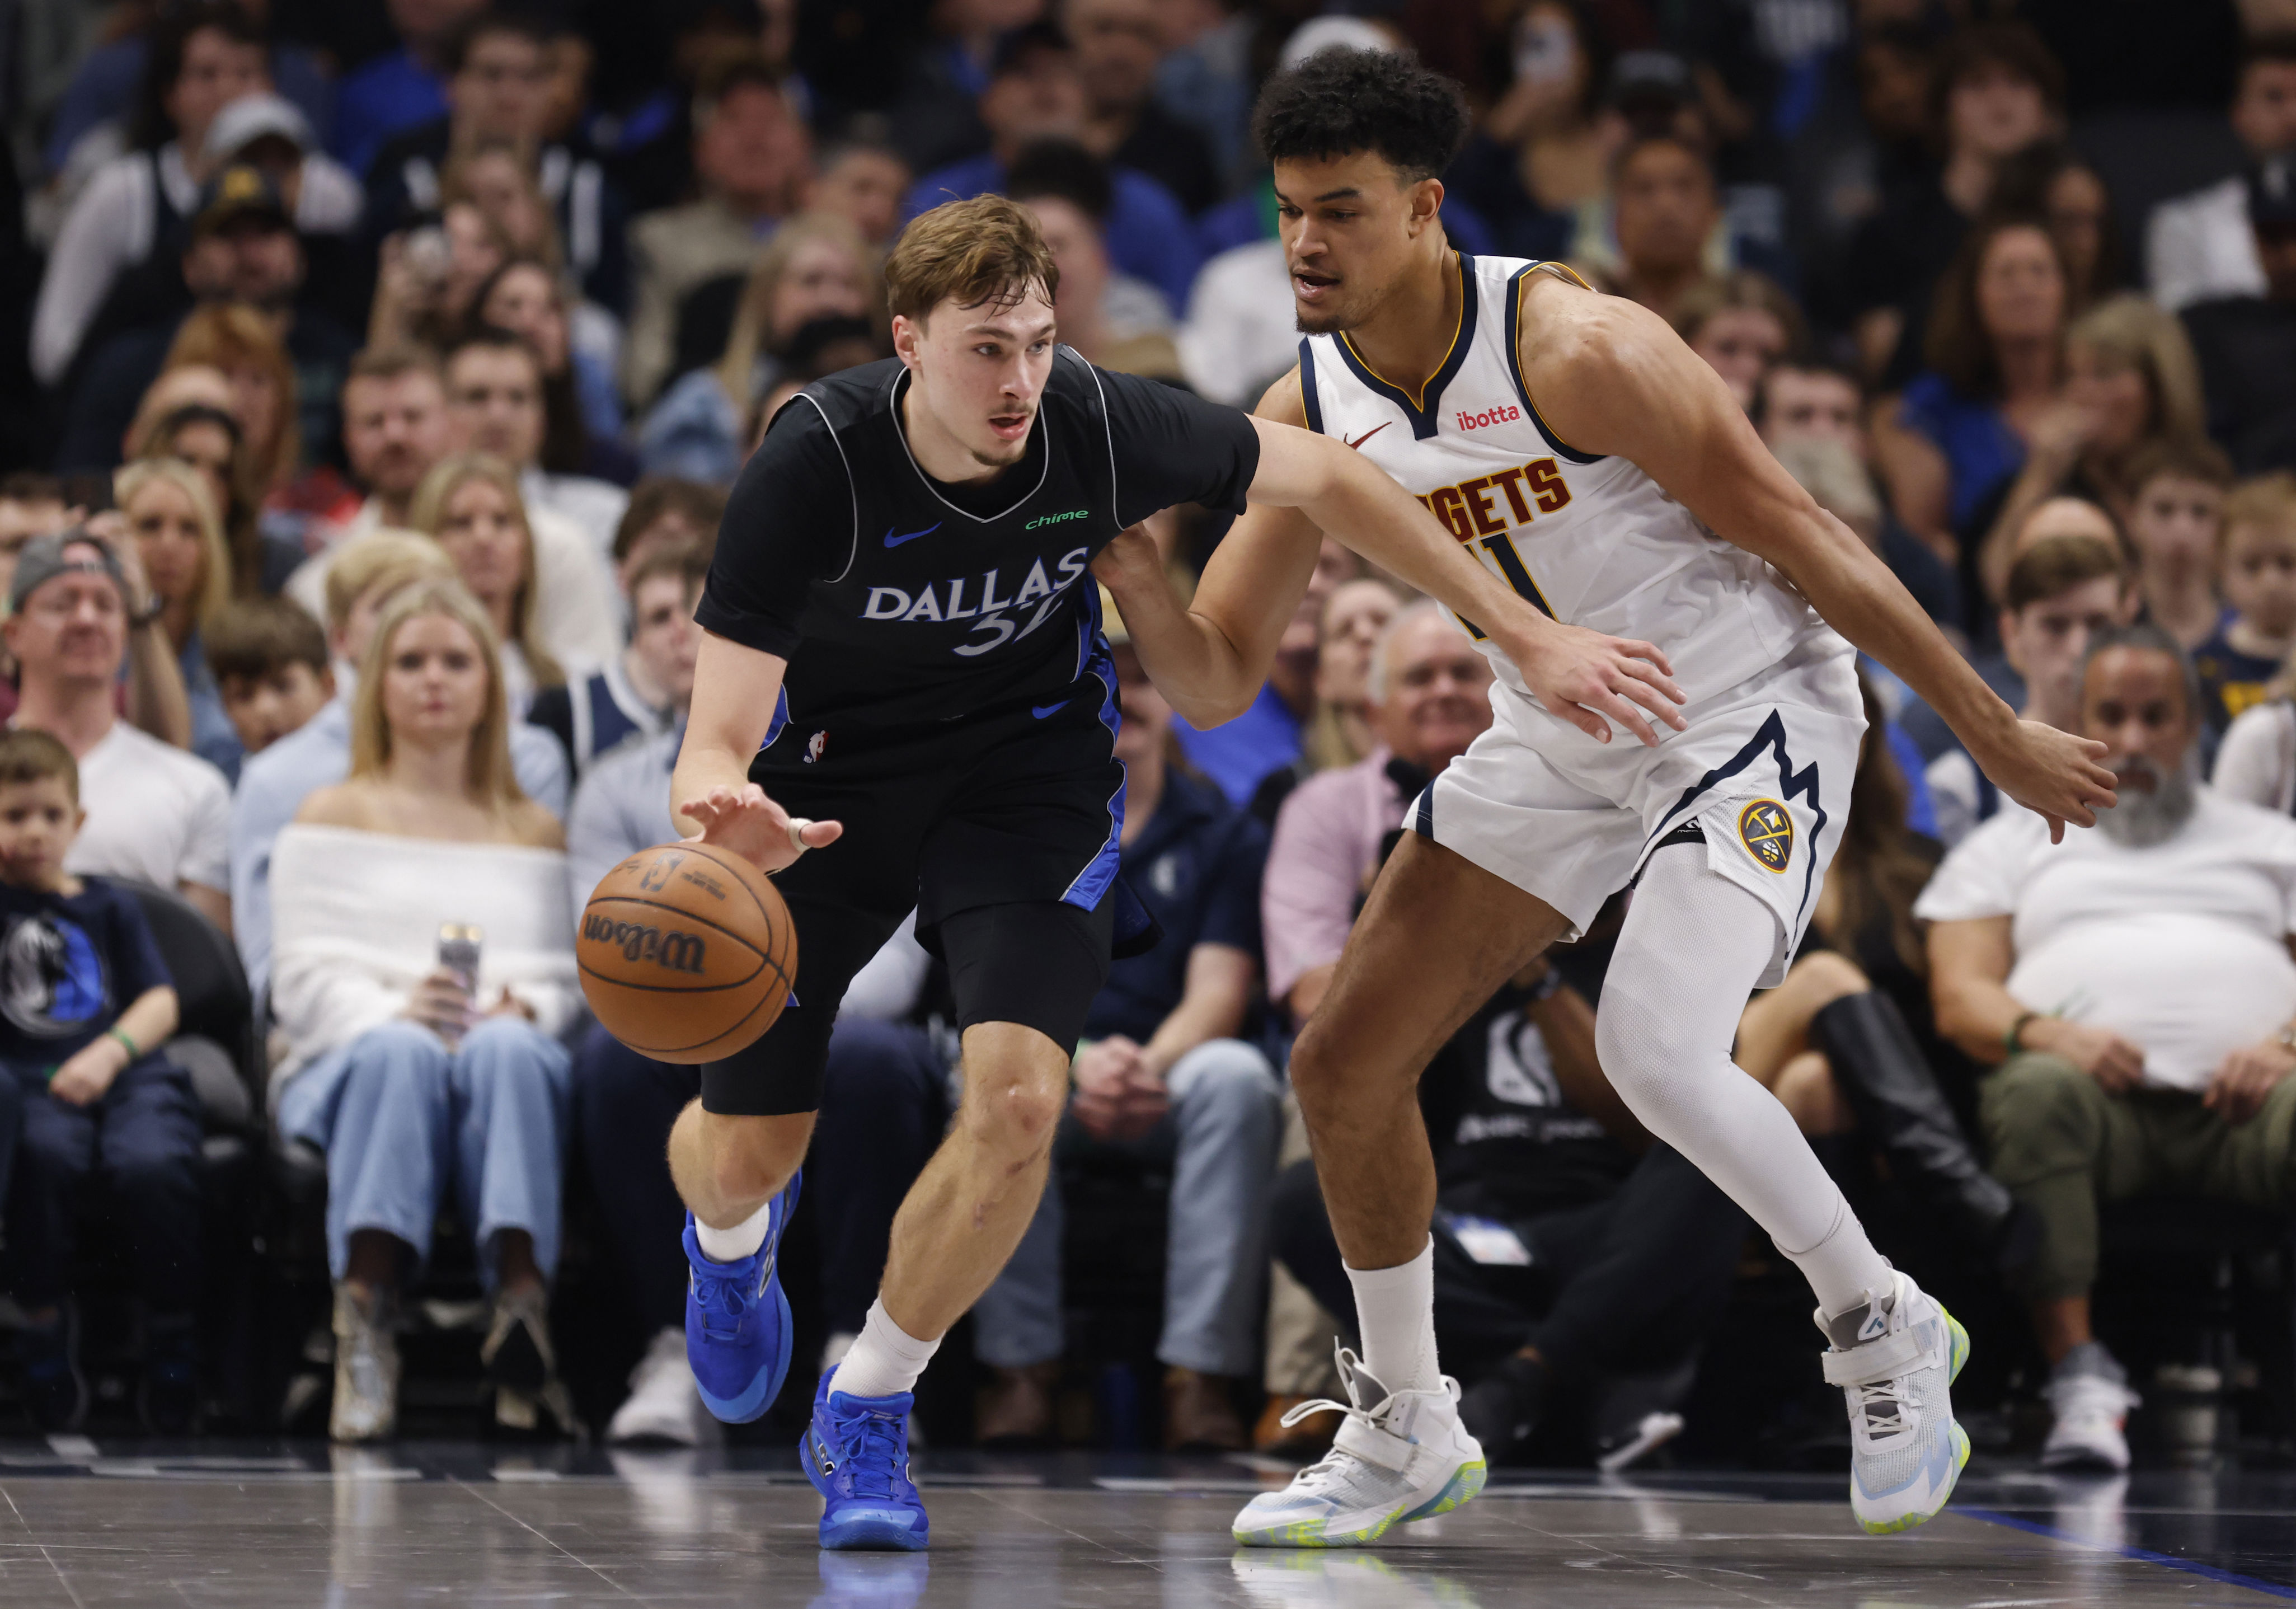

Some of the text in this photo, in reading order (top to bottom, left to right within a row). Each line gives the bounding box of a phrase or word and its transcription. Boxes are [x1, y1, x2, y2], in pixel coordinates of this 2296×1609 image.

[1456, 406, 1520, 431] ibotta
[1025, 510, 1088, 529] chime
[1413, 457, 1572, 543] GETS
[859, 547, 1089, 622] DALLAS
[584, 914, 706, 975] Wilson
